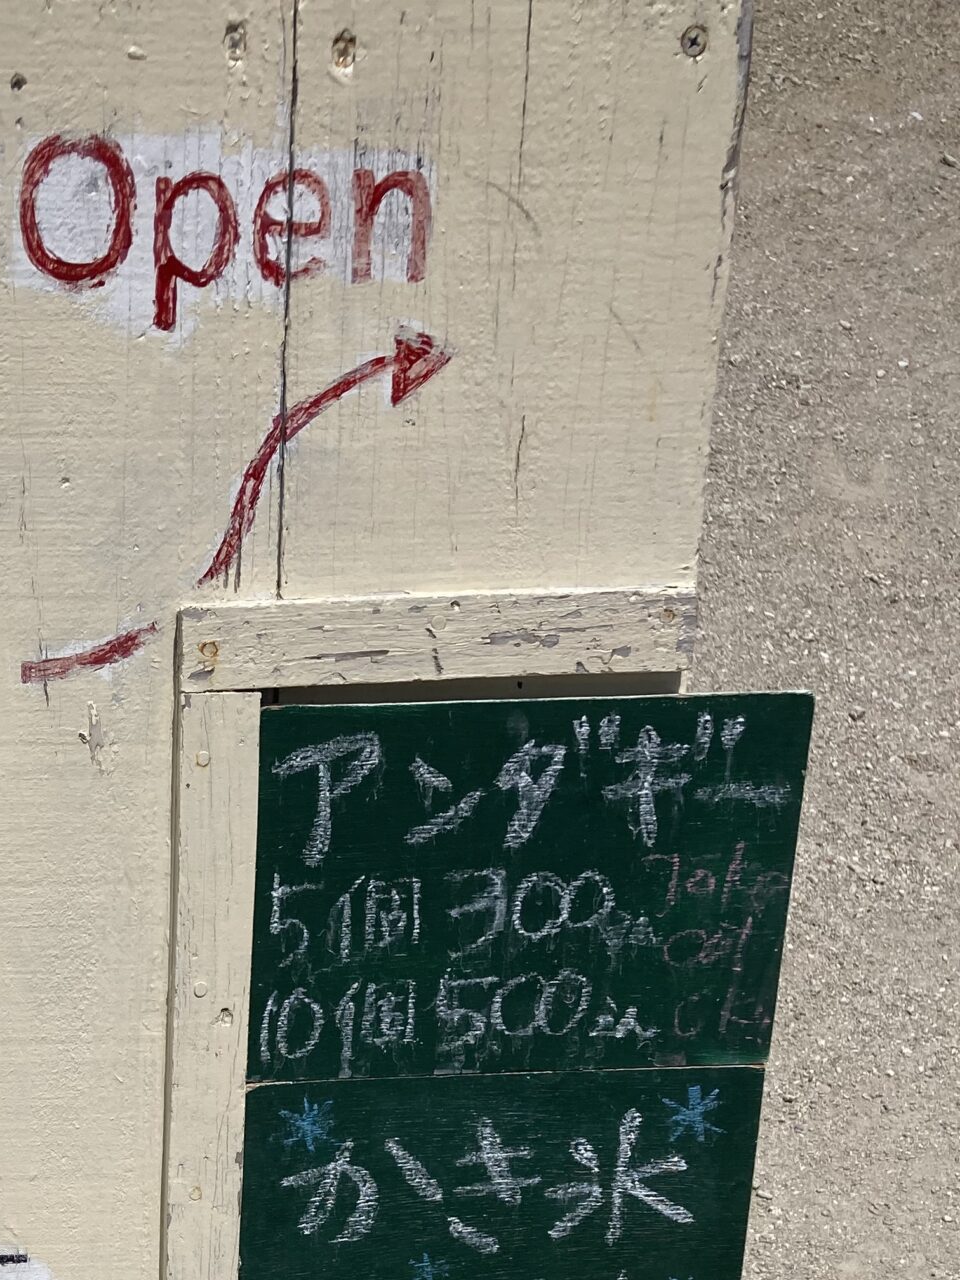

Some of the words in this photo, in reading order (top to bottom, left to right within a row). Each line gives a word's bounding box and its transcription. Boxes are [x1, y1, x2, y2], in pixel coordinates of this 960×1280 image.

[18, 133, 432, 332] Open
[270, 711, 792, 868] アンダギー
[279, 1106, 696, 1256] かき氷
